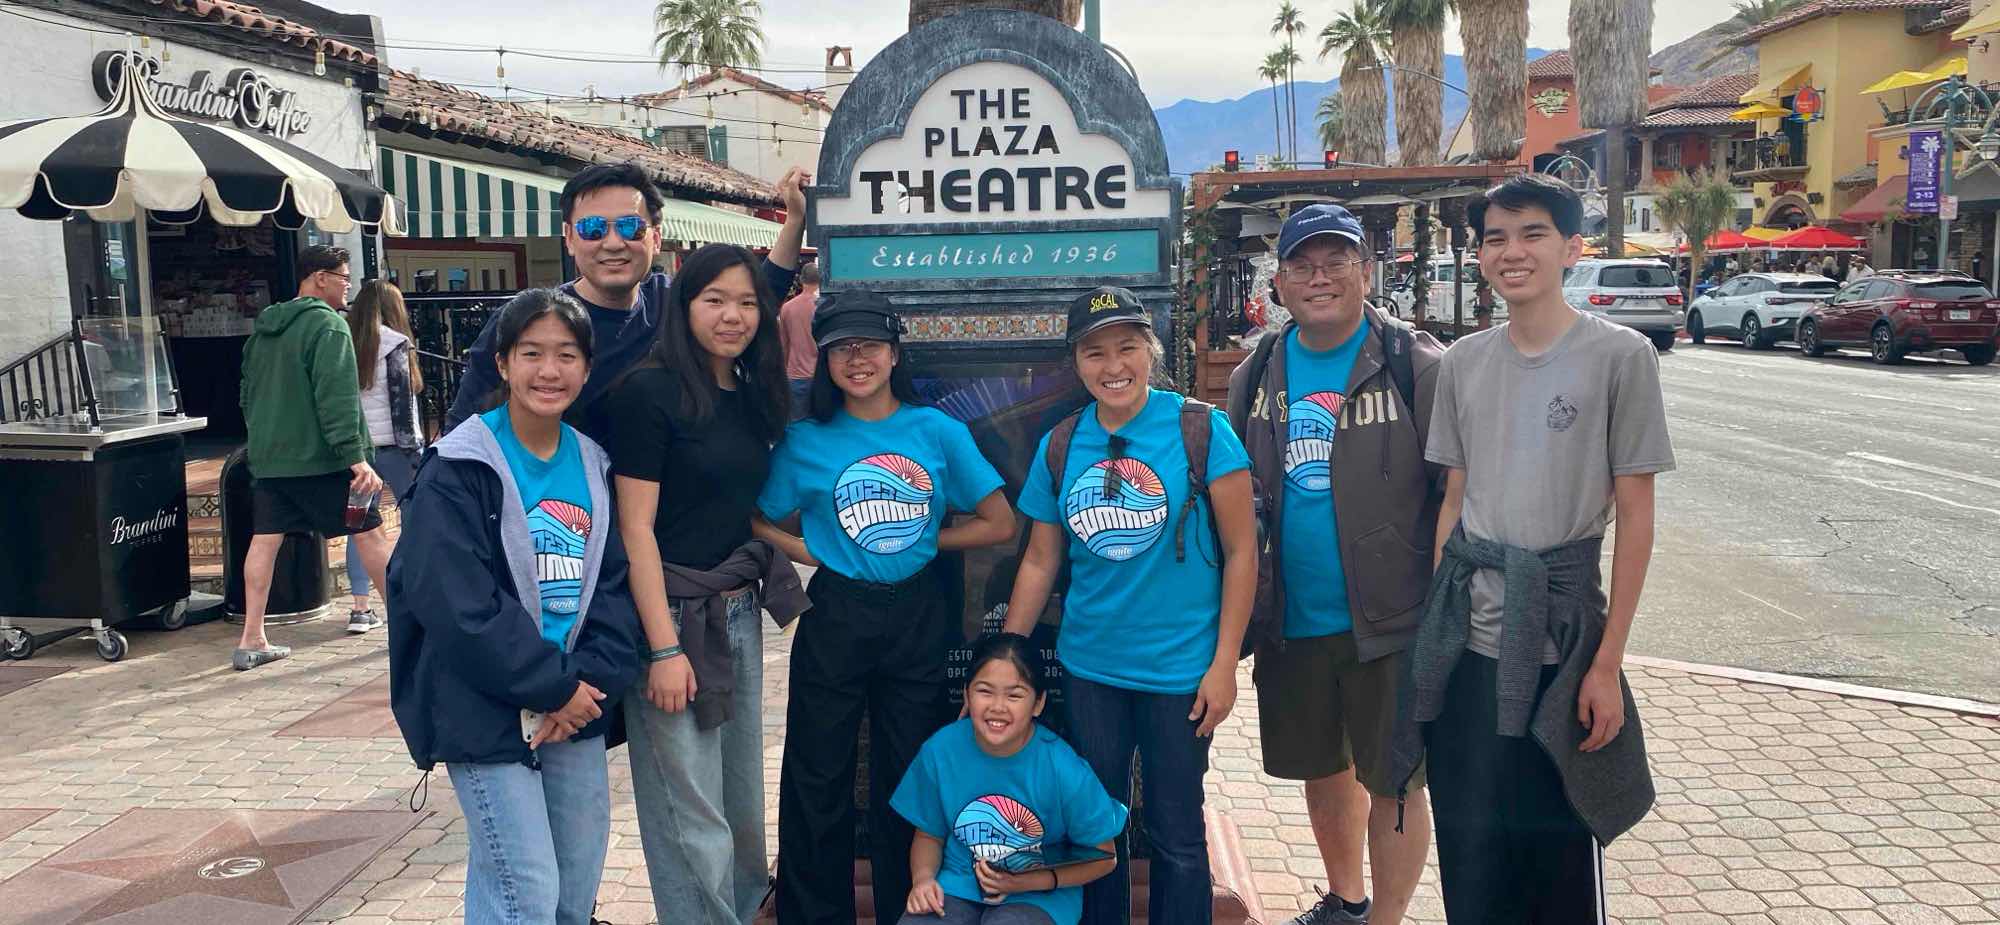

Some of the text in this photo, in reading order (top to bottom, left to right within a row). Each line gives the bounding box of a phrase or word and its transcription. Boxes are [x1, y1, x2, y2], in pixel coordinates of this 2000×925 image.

[236, 68, 311, 141] Toffee
[950, 88, 1031, 120] THE
[924, 125, 1061, 158] PLAZA
[859, 165, 1127, 215] THEATRE
[872, 243, 1118, 268] Established 1936
[110, 506, 178, 545] Brandini
